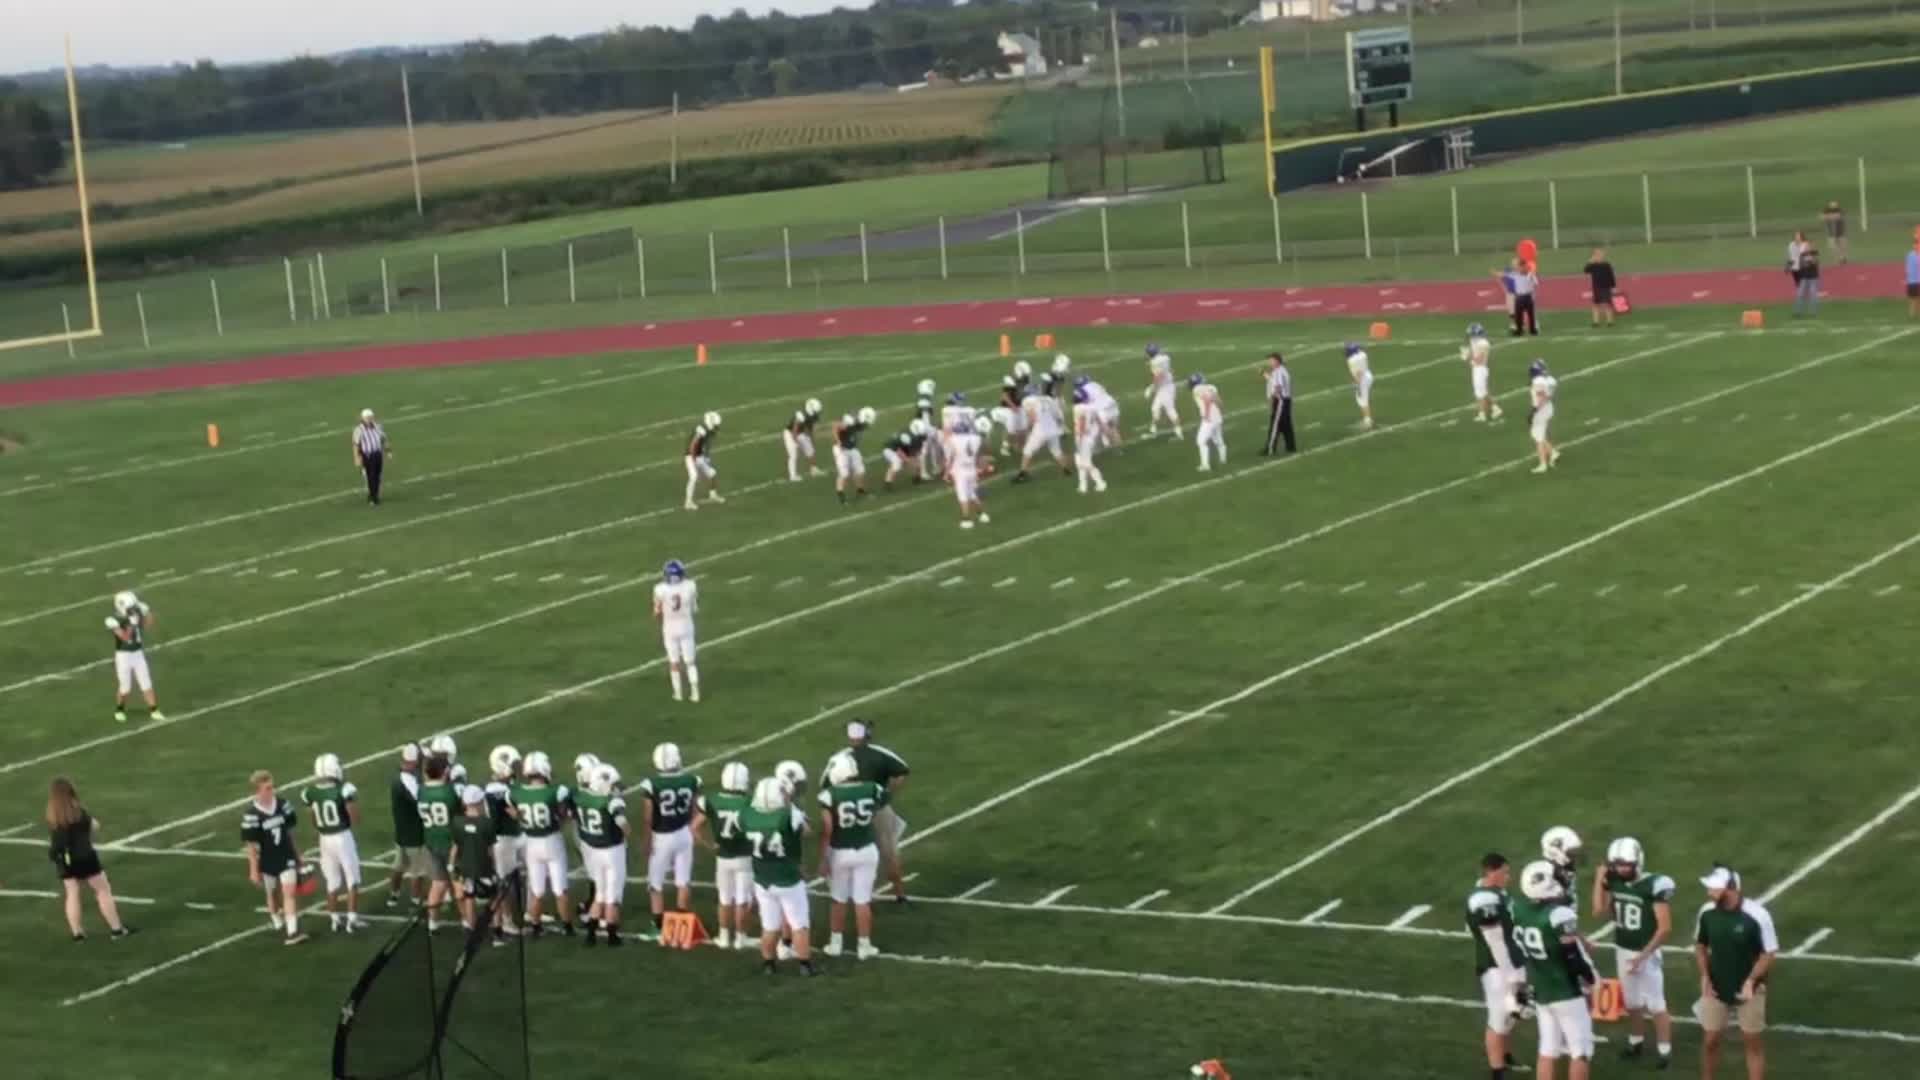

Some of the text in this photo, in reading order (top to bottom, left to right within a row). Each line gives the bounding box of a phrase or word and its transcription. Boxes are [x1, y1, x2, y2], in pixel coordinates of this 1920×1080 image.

[311, 800, 340, 828] 10
[418, 801, 450, 828] 58
[659, 787, 693, 817] 23
[837, 798, 874, 828] 65
[577, 805, 604, 835] 12
[271, 827, 281, 846] 7
[745, 830, 785, 858] 74
[1614, 900, 1642, 930] 18
